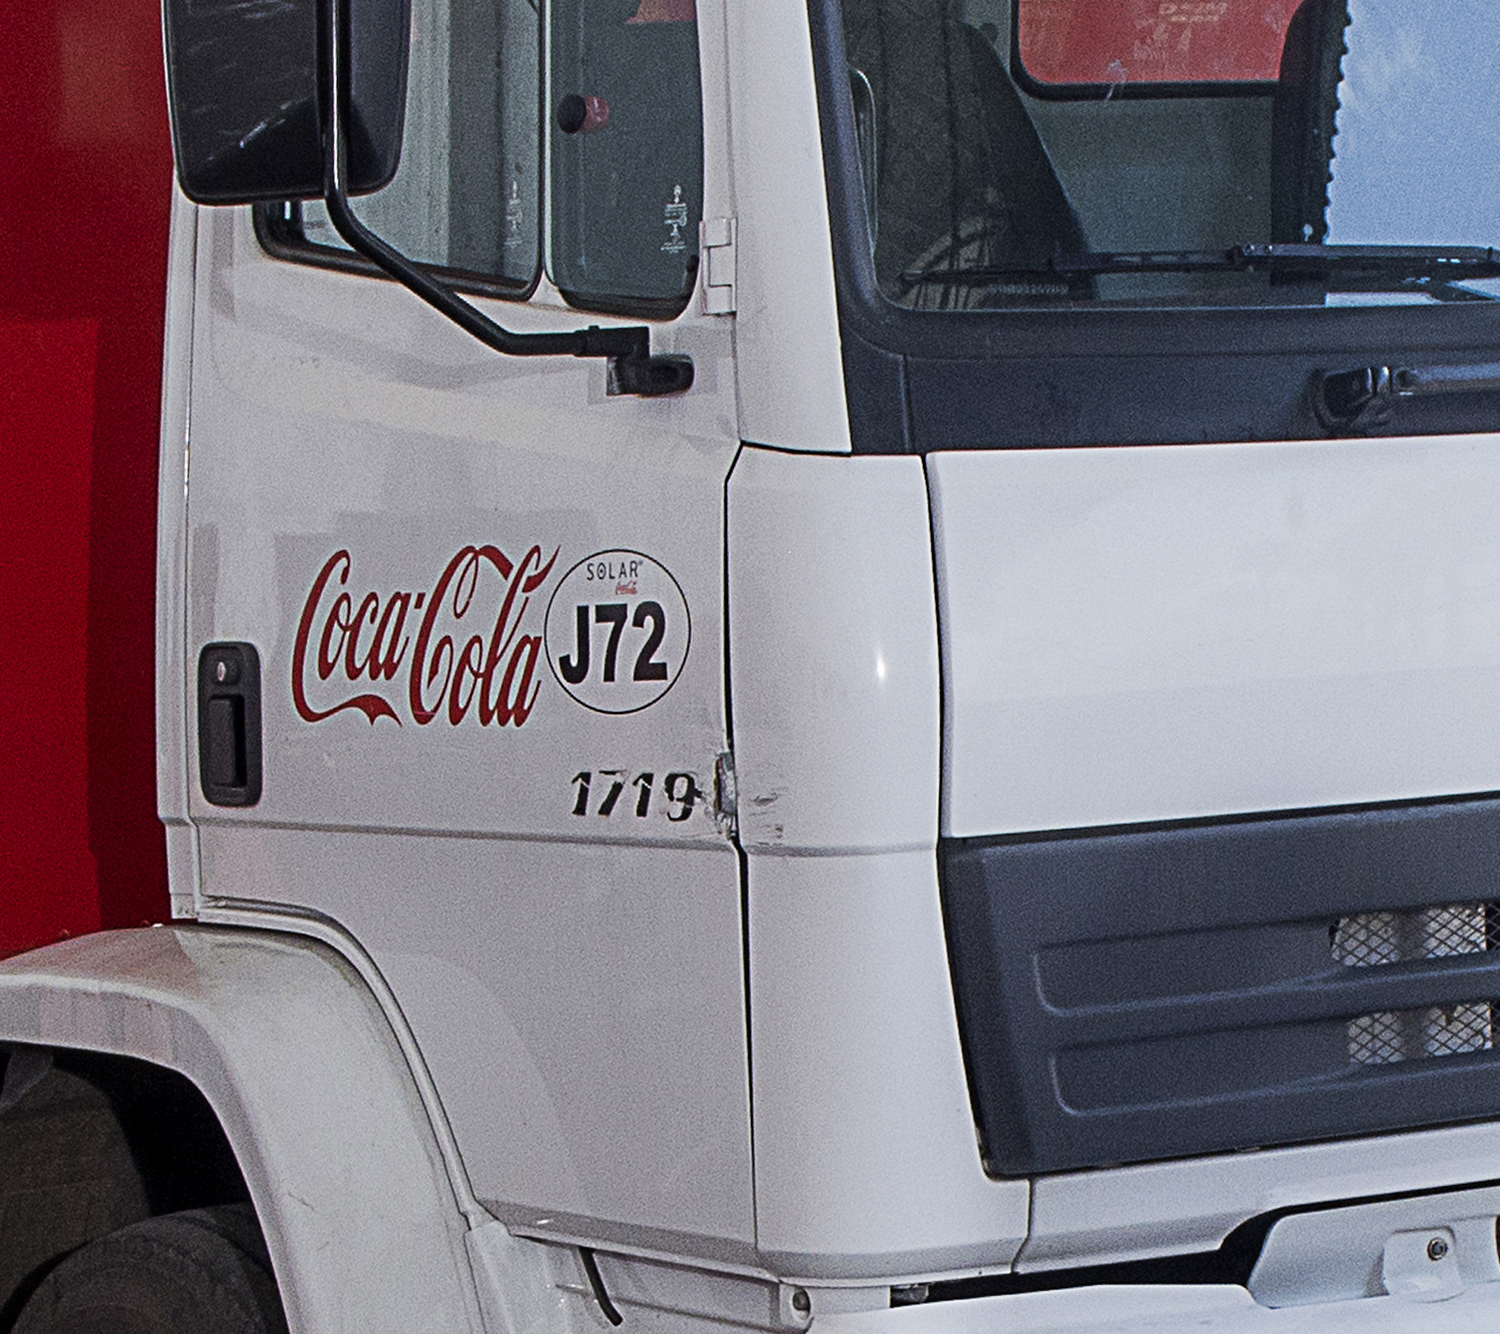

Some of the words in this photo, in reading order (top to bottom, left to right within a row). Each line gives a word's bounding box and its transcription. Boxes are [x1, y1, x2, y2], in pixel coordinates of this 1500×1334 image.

[586, 560, 640, 581] SOLAR
[291, 544, 561, 728] Coca-Cola
[559, 600, 668, 685] J72
[571, 769, 700, 823] 1719
